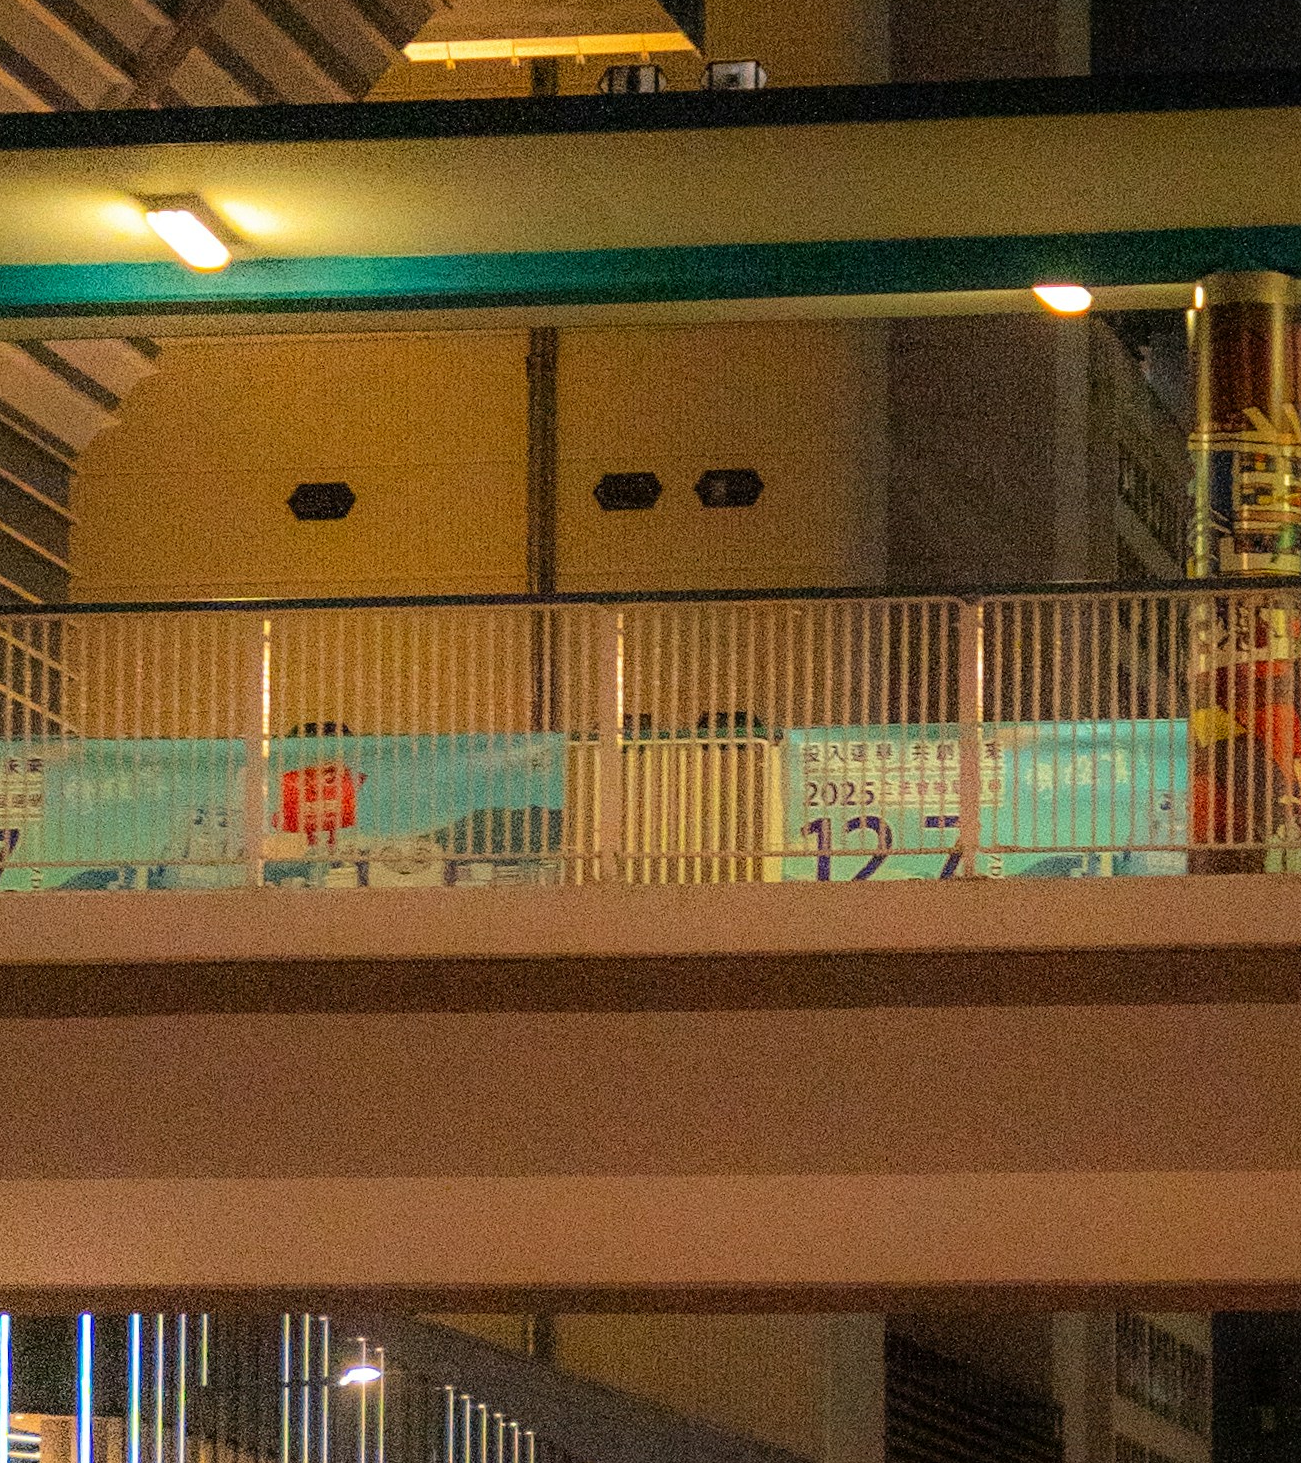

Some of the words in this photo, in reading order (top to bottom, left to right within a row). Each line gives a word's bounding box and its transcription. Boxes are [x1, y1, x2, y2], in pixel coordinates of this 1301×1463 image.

[912, 740, 1003, 762] 共創來
[806, 782, 875, 806] 2025
[801, 816, 892, 881] 12
